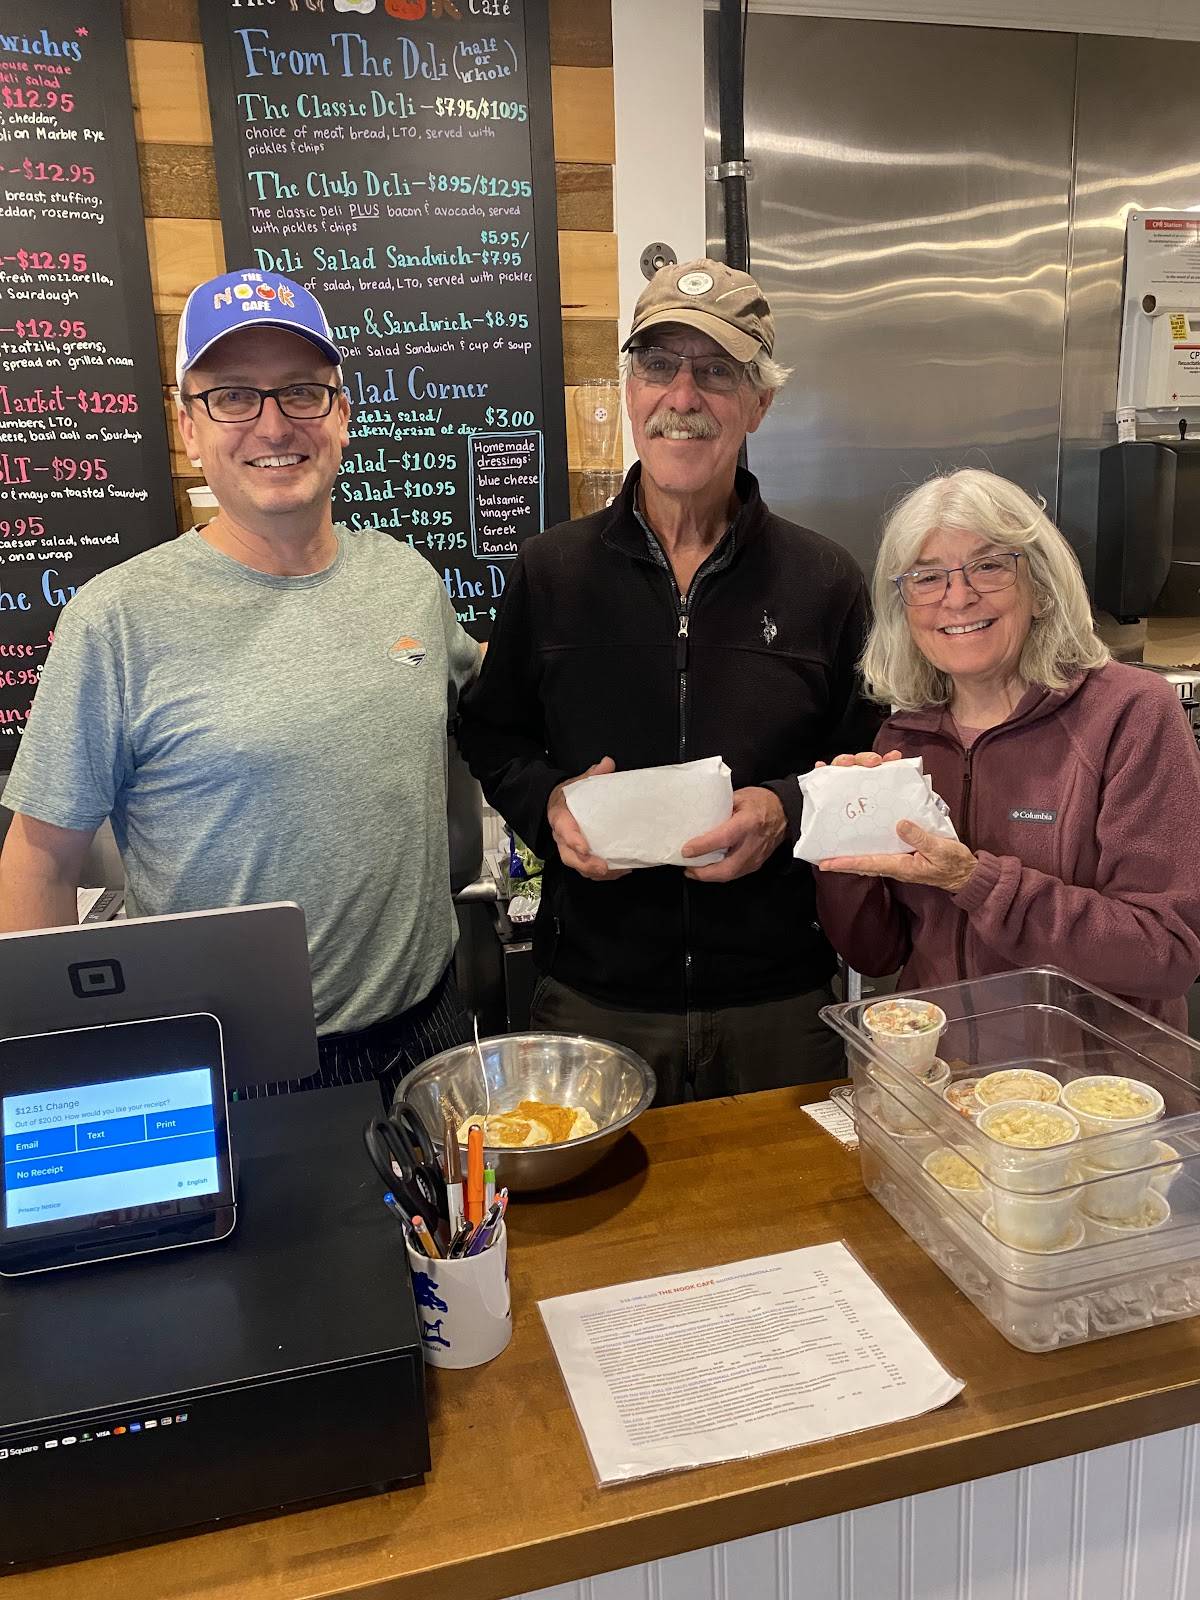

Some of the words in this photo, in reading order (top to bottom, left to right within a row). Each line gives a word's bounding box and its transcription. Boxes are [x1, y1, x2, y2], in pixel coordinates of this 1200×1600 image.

[234, 28, 330, 77] From
[331, 33, 393, 77] The
[397, 37, 448, 80] Deli
[475, 55, 491, 66] or
[34, 63, 72, 74] made
[25, 75, 60, 88] salad
[237, 93, 290, 121] The
[297, 94, 367, 118] Classic
[371, 91, 416, 118] Deli
[9, 112, 58, 127] cheddar,
[14, 129, 30, 139] on
[36, 127, 78, 140] Marble
[84, 129, 105, 143] Rye
[245, 126, 287, 140] choice
[294, 124, 307, 138] of
[313, 125, 344, 139] meat,
[349, 126, 390, 140] bread,
[425, 126, 463, 139] served
[468, 125, 496, 139] with
[248, 142, 287, 158] pickles
[298, 142, 325, 155] chips
[248, 171, 300, 200] The
[306, 171, 358, 198] Club
[363, 170, 412, 197] Deli
[5, 190, 47, 203] breast,
[50, 192, 103, 208] stuffing,
[41, 208, 104, 224] rosemary
[249, 206, 271, 218] The
[276, 206, 317, 218] classic
[320, 205, 343, 217] Deli
[349, 203, 380, 219] PLUS
[387, 205, 422, 217] bacon
[434, 204, 486, 218] avocado,
[488, 205, 521, 217] served
[252, 221, 279, 234] with
[282, 221, 318, 237] pickles
[329, 221, 358, 236] chips
[254, 248, 304, 272] Deli
[313, 247, 377, 271] Salad
[386, 245, 474, 268] Sandwich
[0, 272, 33, 283] fresh
[38, 272, 114, 287] mozzarella,
[241, 273, 263, 282] THE
[304, 277, 316, 290] of
[323, 280, 355, 291] salad,
[359, 278, 395, 291] bread,
[397, 278, 423, 289] LTO,
[427, 273, 464, 287] served
[470, 271, 494, 283] with
[499, 271, 533, 285] pickles
[7, 287, 79, 306] Sourdough
[363, 308, 384, 338] &
[383, 310, 472, 335] Sandwich
[1, 340, 60, 354] tzatziki,
[62, 341, 107, 355] greens,
[339, 345, 361, 358] Deli
[366, 343, 400, 357] Salad
[405, 341, 455, 355] Sandwich
[469, 341, 489, 353] cup
[493, 338, 504, 349] of
[508, 341, 532, 354] soup
[2, 357, 43, 372] spread
[46, 358, 61, 367] on
[68, 355, 104, 371] grilled
[107, 357, 134, 367] naan
[408, 365, 488, 400] Corner
[48, 417, 78, 429] LTO,
[356, 409, 392, 423] deli
[485, 406, 535, 427] $3.00
[29, 431, 56, 442] basil
[441, 424, 454, 434] of
[474, 439, 535, 454] Homemade
[477, 454, 531, 469] dressings:
[478, 474, 500, 487] blue
[504, 474, 539, 485] cheese
[18, 491, 49, 504] mayo
[51, 491, 63, 499] on
[63, 487, 105, 498] toasted
[341, 480, 396, 503] Salad
[479, 494, 524, 506] balsamic
[351, 508, 402, 534] Salad
[481, 505, 531, 521] vinagrette
[483, 525, 516, 536] Greek
[0, 540, 36, 549] caesar
[41, 535, 77, 547] salad,
[80, 533, 120, 545] shaved
[483, 541, 518, 552] Ranch
[8, 553, 25, 562] on
[38, 551, 73, 561] wrap
[442, 568, 485, 599] the
[1019, 810, 1053, 821] Columbia
[15, 1105, 43, 1116] $12.51
[46, 1100, 80, 1111] Change
[15, 1120, 27, 1129] Out
[29, 1118, 37, 1126] of
[65, 1112, 80, 1121] How
[81, 1110, 101, 1119] would
[102, 1108, 115, 1117] you
[115, 1104, 128, 1113] like
[128, 1103, 143, 1112] your
[156, 1120, 177, 1129] Print
[87, 1130, 106, 1140] Text
[16, 1140, 39, 1151] Email
[16, 1170, 29, 1180] No
[31, 1165, 64, 1179] Receipt
[657, 1288, 674, 1297] THE
[673, 1283, 696, 1294] NOOK
[96, 1430, 111, 1439] VISA
[9, 1445, 39, 1457] Square
